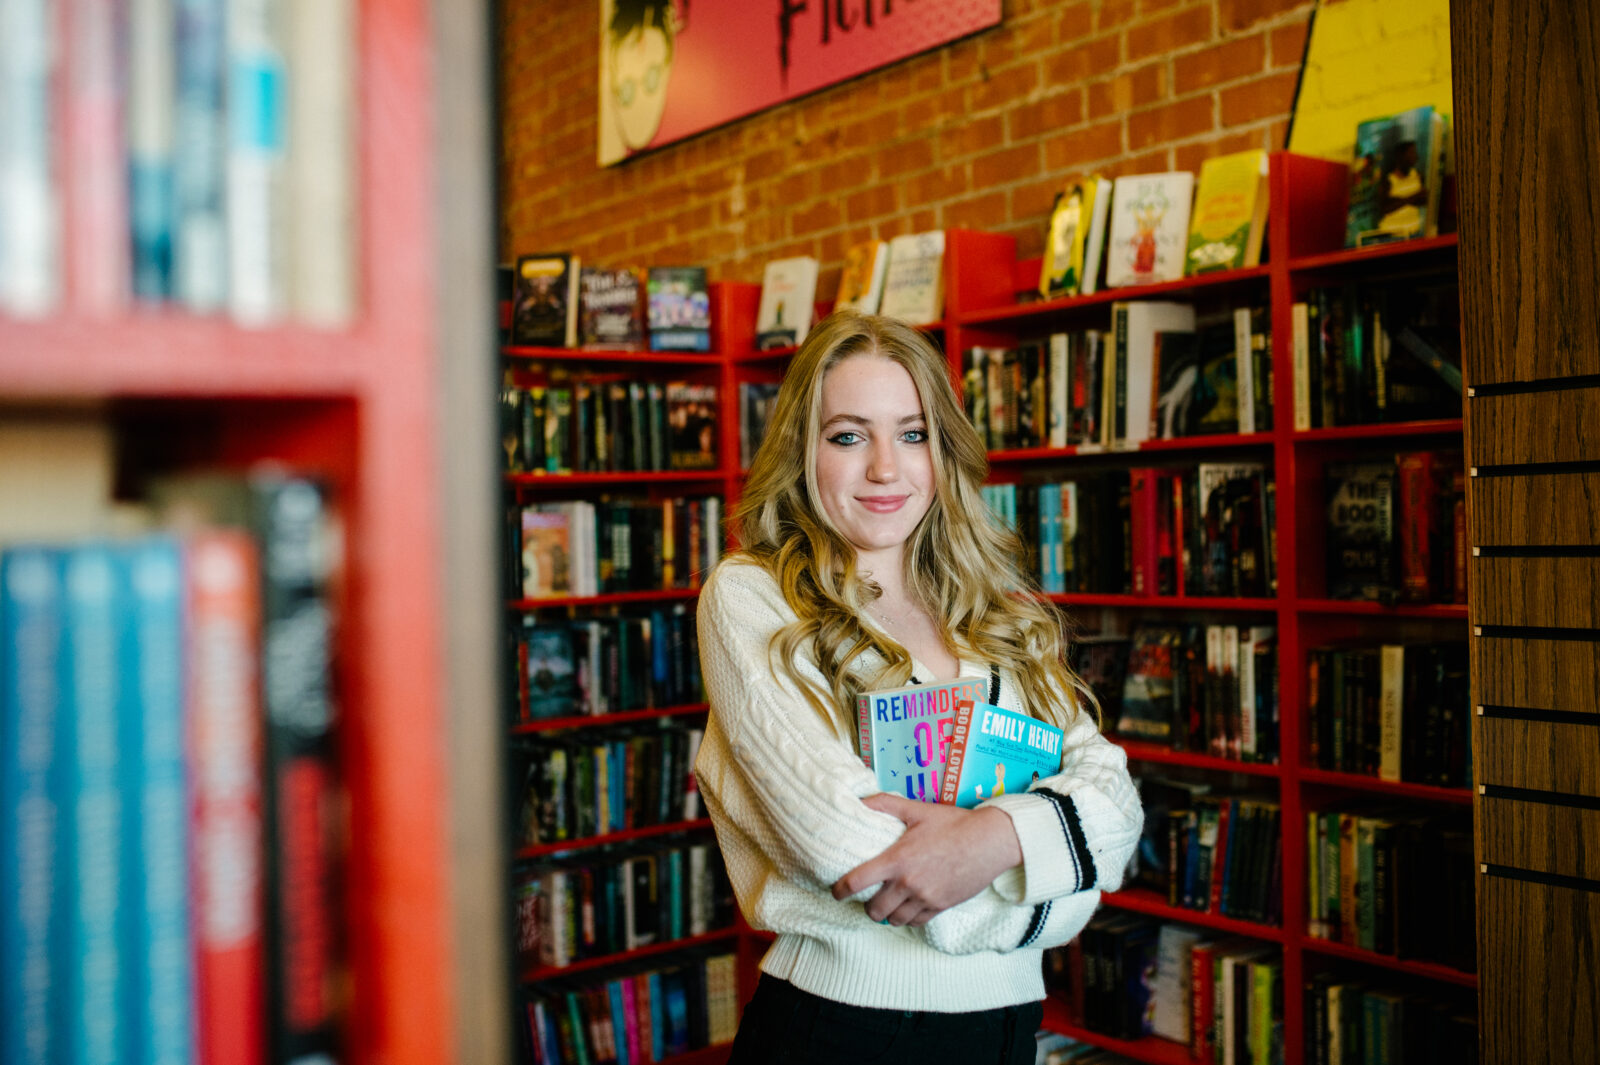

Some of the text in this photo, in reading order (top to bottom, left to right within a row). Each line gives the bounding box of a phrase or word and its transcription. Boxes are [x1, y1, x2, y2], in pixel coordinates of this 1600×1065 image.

[859, 698, 871, 752] COLLEEN
[876, 683, 985, 722] REMINDERS
[914, 717, 954, 768] OF
[943, 706, 970, 802] BOOK LOVERS
[981, 710, 1025, 743] EMILY
[1028, 724, 1060, 756] HENRY
